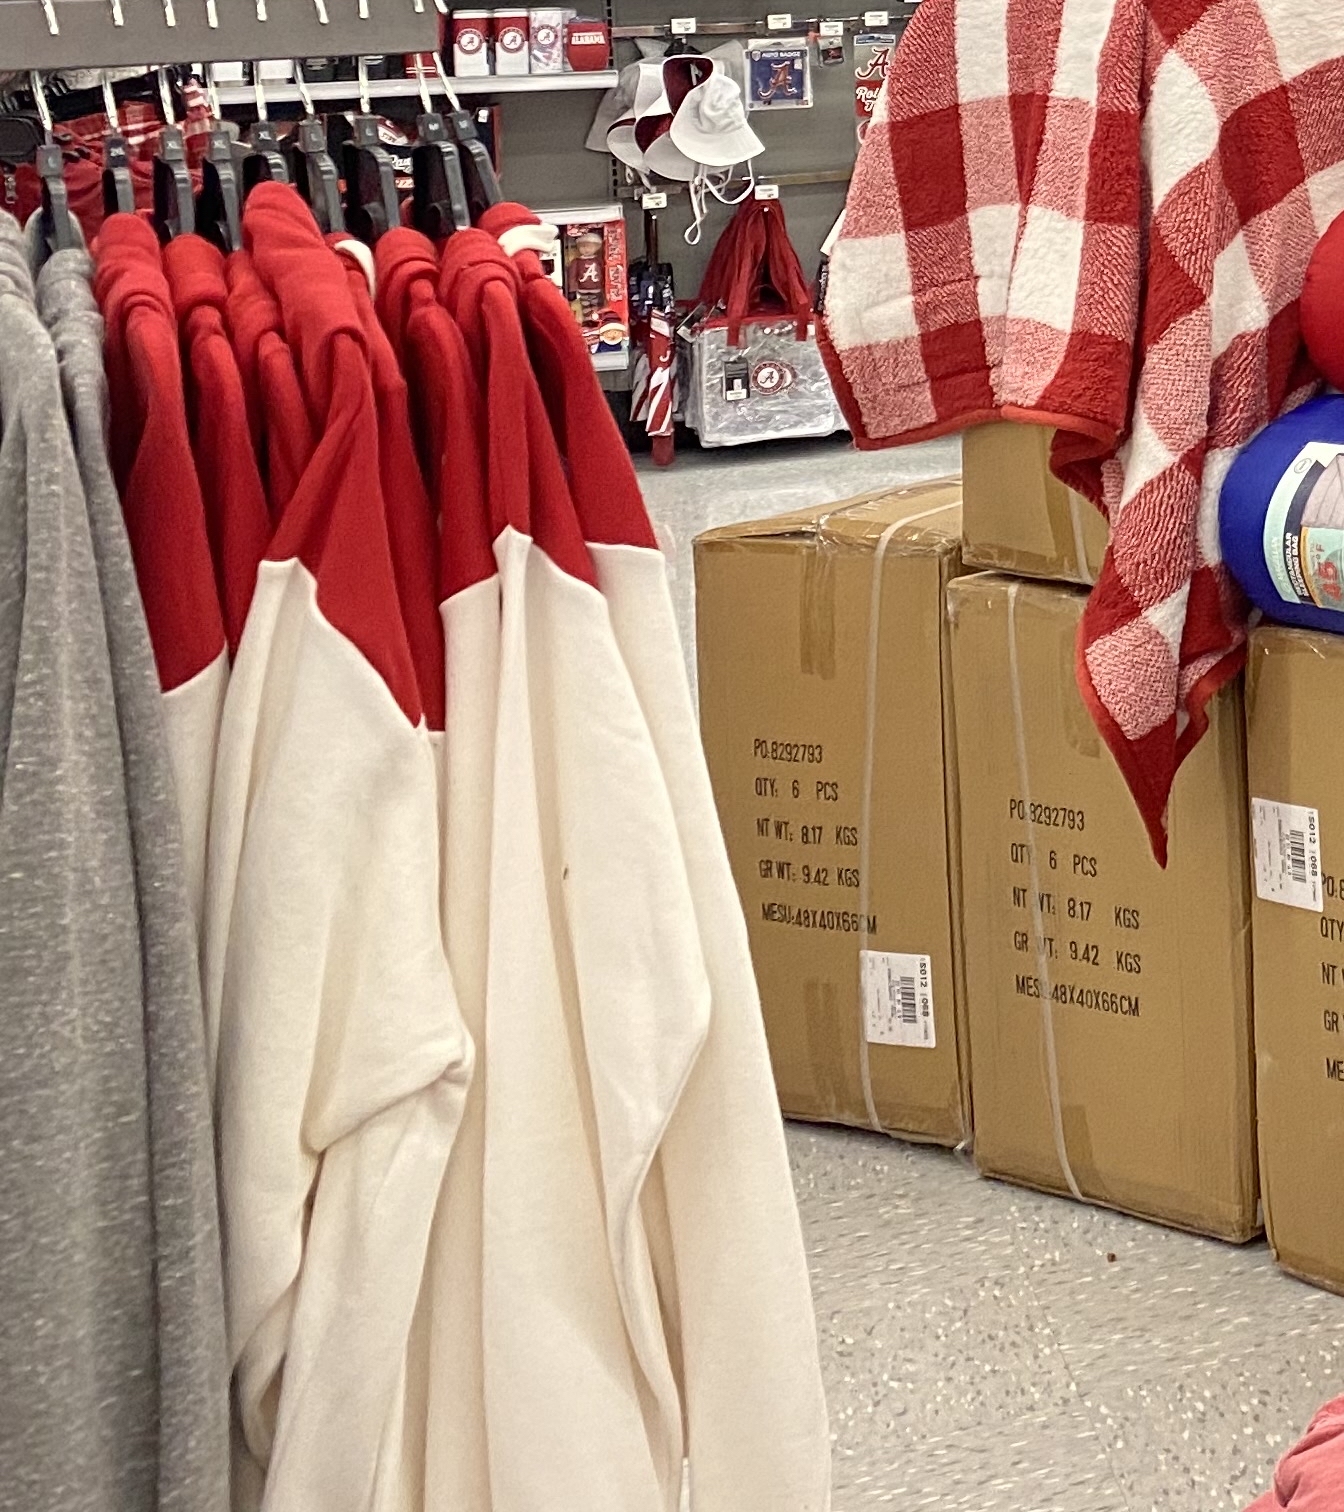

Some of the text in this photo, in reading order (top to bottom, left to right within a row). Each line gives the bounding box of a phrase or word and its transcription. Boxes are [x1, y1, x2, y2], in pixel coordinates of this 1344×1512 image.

[779, 50, 801, 59] BADGE
[1291, 535, 1299, 556] BAG
[755, 777, 839, 802] QTY: 6 PCS
[1009, 798, 1085, 832] PO8292793
[756, 818, 858, 847] NT WT: 8.17 KGS
[759, 859, 860, 888] GR WT: 9.42 KGS
[1049, 850, 1098, 877] 6 PCS
[1012, 886, 1140, 930] NT 8.17 KGS
[1014, 931, 1142, 974] GR 9.42 KGS
[1321, 961, 1337, 986] NT
[1015, 974, 1141, 1017] MES48X40X66CM
[1323, 1009, 1340, 1033] GR
